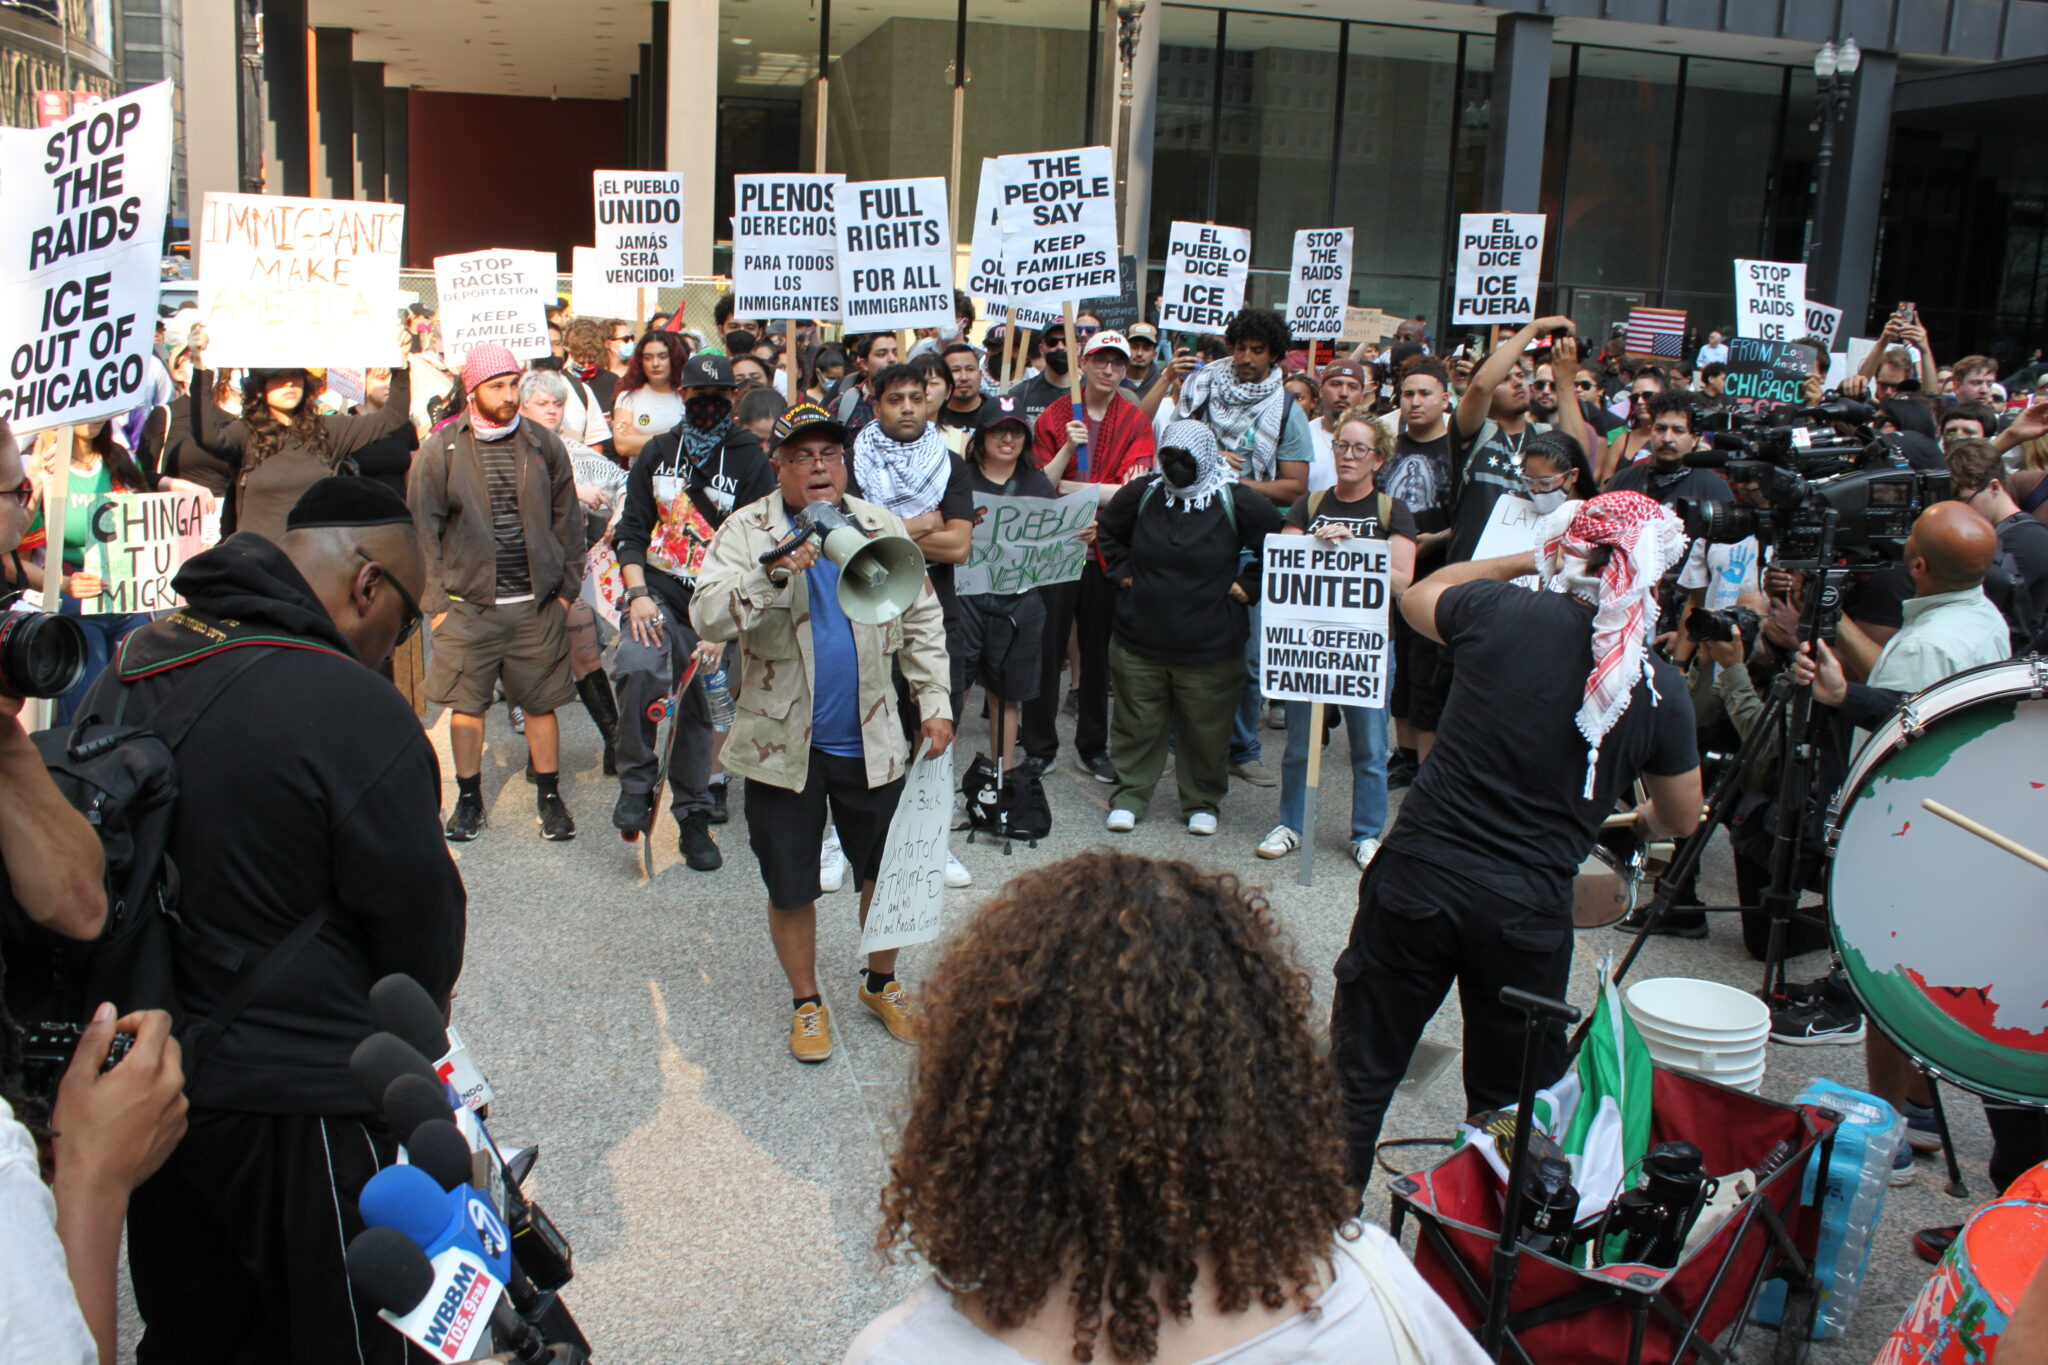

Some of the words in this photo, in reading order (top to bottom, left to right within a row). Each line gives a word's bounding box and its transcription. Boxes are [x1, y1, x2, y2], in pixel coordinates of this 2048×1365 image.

[45, 102, 141, 174] STOP
[1028, 156, 1081, 180] THE
[53, 153, 124, 215] THE
[624, 179, 680, 194] PUEBLO
[1004, 177, 1109, 205] PEOPLE
[600, 199, 681, 225] UNIDO
[859, 186, 923, 220] FULL
[1033, 202, 1084, 226] SAY
[29, 197, 141, 271] RAIDS
[204, 200, 401, 254] IMMIGRANTS
[847, 220, 940, 252] RIGHTS
[1200, 228, 1221, 244] EL
[1492, 219, 1514, 233] EL
[616, 232, 668, 250] JAMÁS
[1033, 234, 1086, 254] KEEP
[1307, 231, 1343, 248] STOP
[1464, 235, 1538, 250] PUEBLO
[620, 245, 659, 267] SERÁ
[1171, 242, 1247, 263] PUEBLO
[1310, 249, 1337, 264] THE
[1478, 251, 1521, 266] DICE
[250, 256, 351, 286] MAKE
[460, 258, 513, 273] STOP
[744, 256, 781, 270] PARA
[787, 256, 834, 271] TODOS
[1016, 251, 1106, 276] FAMILIES
[1185, 260, 1229, 277] DICE
[1301, 265, 1343, 281] RAIDS
[1750, 265, 1790, 282] STOP
[452, 272, 524, 289] RACIST
[605, 268, 675, 283] VENCIDO!
[774, 276, 802, 290] LOS
[853, 268, 895, 293] FOR
[903, 265, 941, 290] ALL
[1010, 269, 1116, 296] TOGETHER
[1476, 276, 1517, 295] ICE
[443, 286, 539, 302] DEPORTATION
[1182, 284, 1225, 307] ICE
[1306, 289, 1332, 304] ICE
[1756, 282, 1785, 299] THE
[41, 271, 112, 333] ICE
[739, 296, 839, 312] INMIGRANTES
[848, 294, 948, 316] IMMIGRANTS
[1295, 306, 1320, 318] OUT
[1323, 305, 1340, 318] OF
[1458, 297, 1530, 315] FUERA
[1750, 299, 1794, 317] RAIDS
[471, 310, 518, 322] KEEP
[1163, 304, 1236, 327] FUERA
[455, 323, 537, 338] FAMILIES
[1289, 320, 1342, 333] CHICAGO
[1759, 323, 1784, 340] ICE
[11, 329, 80, 380] OUT
[89, 313, 135, 360] OF
[1730, 338, 1773, 363] FROM
[92, 495, 201, 543] CHINGA
[124, 543, 170, 578] TU
[1267, 548, 1305, 568] THE
[1311, 550, 1387, 573] PEOPLE
[1267, 573, 1385, 610] UNITED
[1266, 626, 1307, 646] WILL
[1313, 629, 1383, 650] DEFEND
[1267, 648, 1381, 673] IMMIGRANT
[1266, 670, 1379, 699] FAMILIES!
[424, 1261, 476, 1347] WBBM
